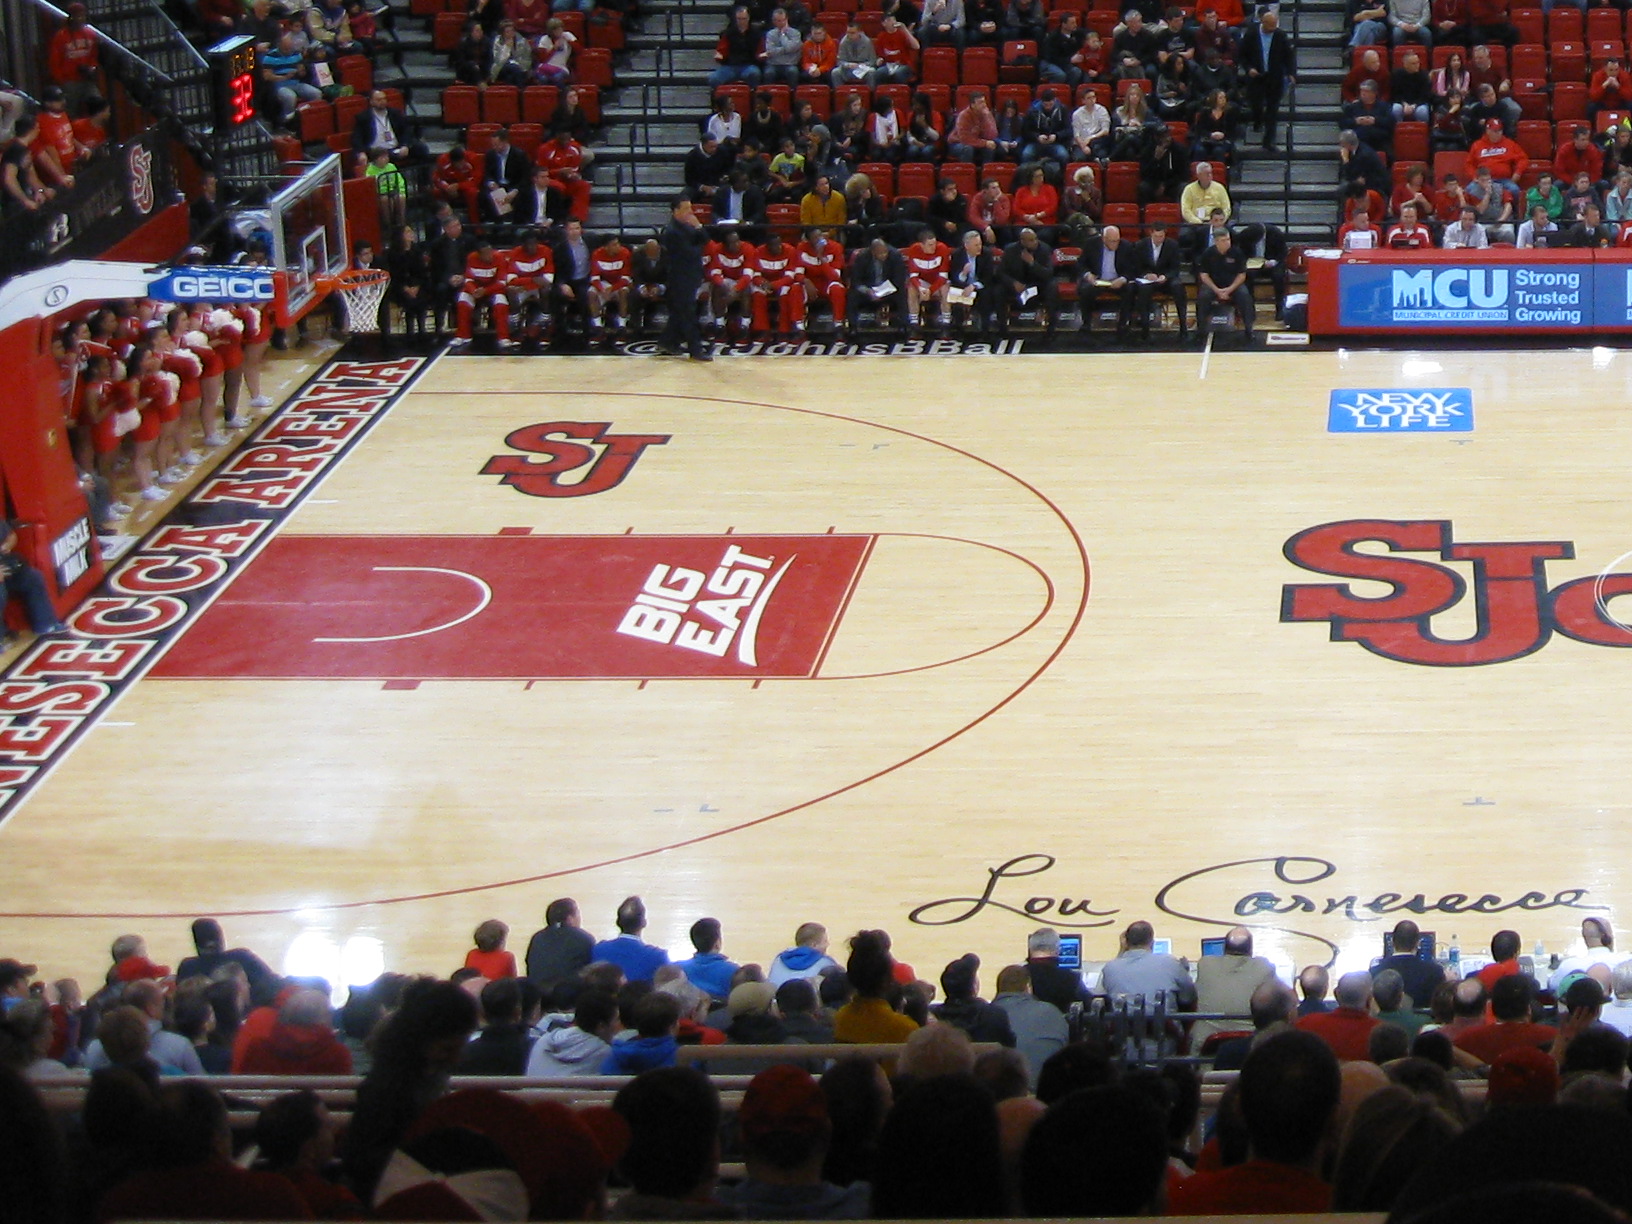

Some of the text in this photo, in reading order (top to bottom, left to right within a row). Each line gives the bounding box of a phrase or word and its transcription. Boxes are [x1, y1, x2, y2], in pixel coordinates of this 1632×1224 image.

[173, 276, 275, 299] GEICO
[1393, 268, 1508, 308] MCU
[1515, 269, 1580, 288] Strong
[1515, 290, 1579, 304] Trusted
[1394, 311, 1507, 320] MUNICIPAL CREDIT UNION
[1515, 307, 1582, 324] Growing
[1356, 392, 1453, 405] NEW
[1337, 402, 1465, 416] YORK
[1356, 415, 1452, 428] LIFE
[190, 356, 427, 509] ARENA
[616, 563, 706, 644] BIG
[674, 544, 774, 657] EAST
[909, 853, 1121, 927] Lou
